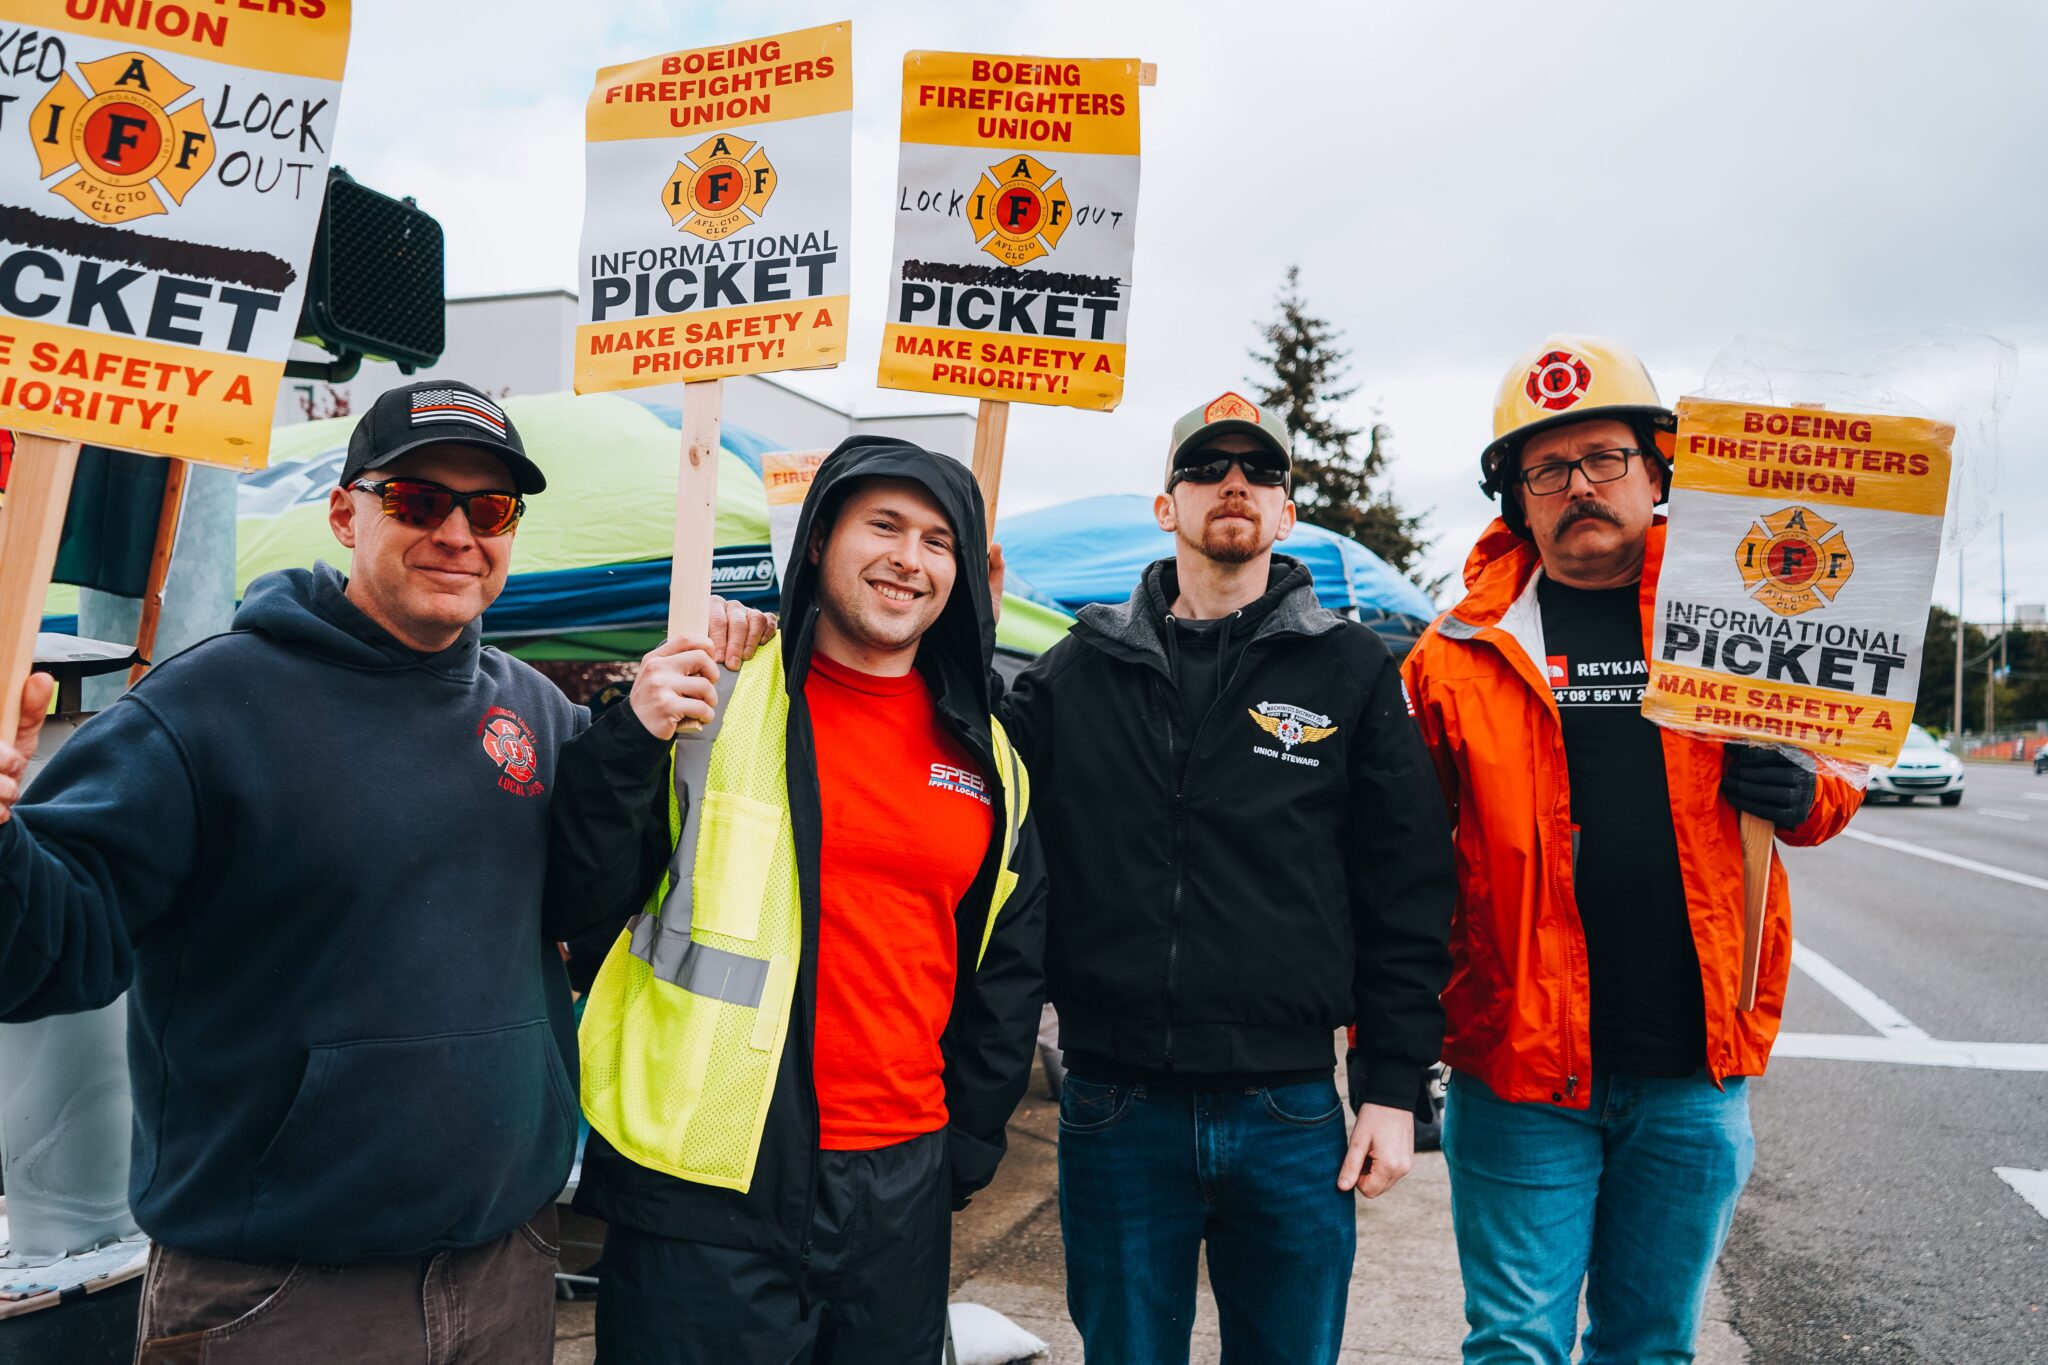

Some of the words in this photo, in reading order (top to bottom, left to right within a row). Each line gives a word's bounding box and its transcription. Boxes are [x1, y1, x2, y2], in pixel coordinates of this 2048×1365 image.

[65, 0, 228, 47] UNION
[661, 40, 781, 75] BOEING
[972, 60, 1080, 86] BOEING
[114, 58, 151, 92] A
[605, 56, 835, 104] FIREFIGHTERS
[670, 94, 771, 128] UNION
[919, 85, 1125, 116] FIREFIGHTERS
[212, 84, 328, 154] LOCK
[977, 117, 1072, 142] UNION
[709, 137, 732, 158] A
[218, 151, 313, 200] OUT
[1011, 159, 1032, 179] A
[75, 180, 146, 203] AFL-CIO
[900, 187, 964, 217] LOCK
[91, 200, 126, 215] CLC
[694, 214, 740, 228] AFL-CIO
[1076, 205, 1123, 229] OUT
[706, 226, 728, 235] CLC
[995, 240, 1035, 252] AFL-CIO
[591, 229, 839, 277] INFORMATIONAL
[1005, 252, 1024, 260] CLC
[0, 250, 281, 354] CKET
[592, 252, 837, 322] PICKET
[899, 283, 1119, 340] PICKET
[591, 326, 675, 356] MAKE
[685, 312, 803, 343] SAFETY
[812, 309, 833, 328] A
[632, 338, 785, 375] PRIORITY!
[895, 336, 972, 360] MAKE
[981, 343, 1086, 371] SAFETY
[1094, 354, 1111, 374] A
[29, 342, 214, 397] SAFETY
[222, 375, 253, 405] A
[932, 363, 1069, 394] PRIORITY!
[1744, 412, 1872, 443] BOEING
[1690, 435, 1929, 476] FIREFIGHTERS
[1747, 467, 1855, 497] UNION
[1785, 510, 1808, 531] A
[1765, 589, 1809, 603] AFLCIO
[1666, 600, 1907, 657] INFORMATIONAL
[1662, 622, 1905, 696] PICKET
[1619, 689, 1632, 702] W
[1658, 673, 1738, 704] MAKE
[1746, 690, 1864, 725] SAFETY
[1872, 710, 1892, 731] A
[1695, 704, 1843, 746] PRIORITY!
[1253, 746, 1278, 758] UNION
[1281, 753, 1319, 767] STEWARD
[498, 775, 526, 796] LOCAL
[955, 786, 979, 799] LOCAL
